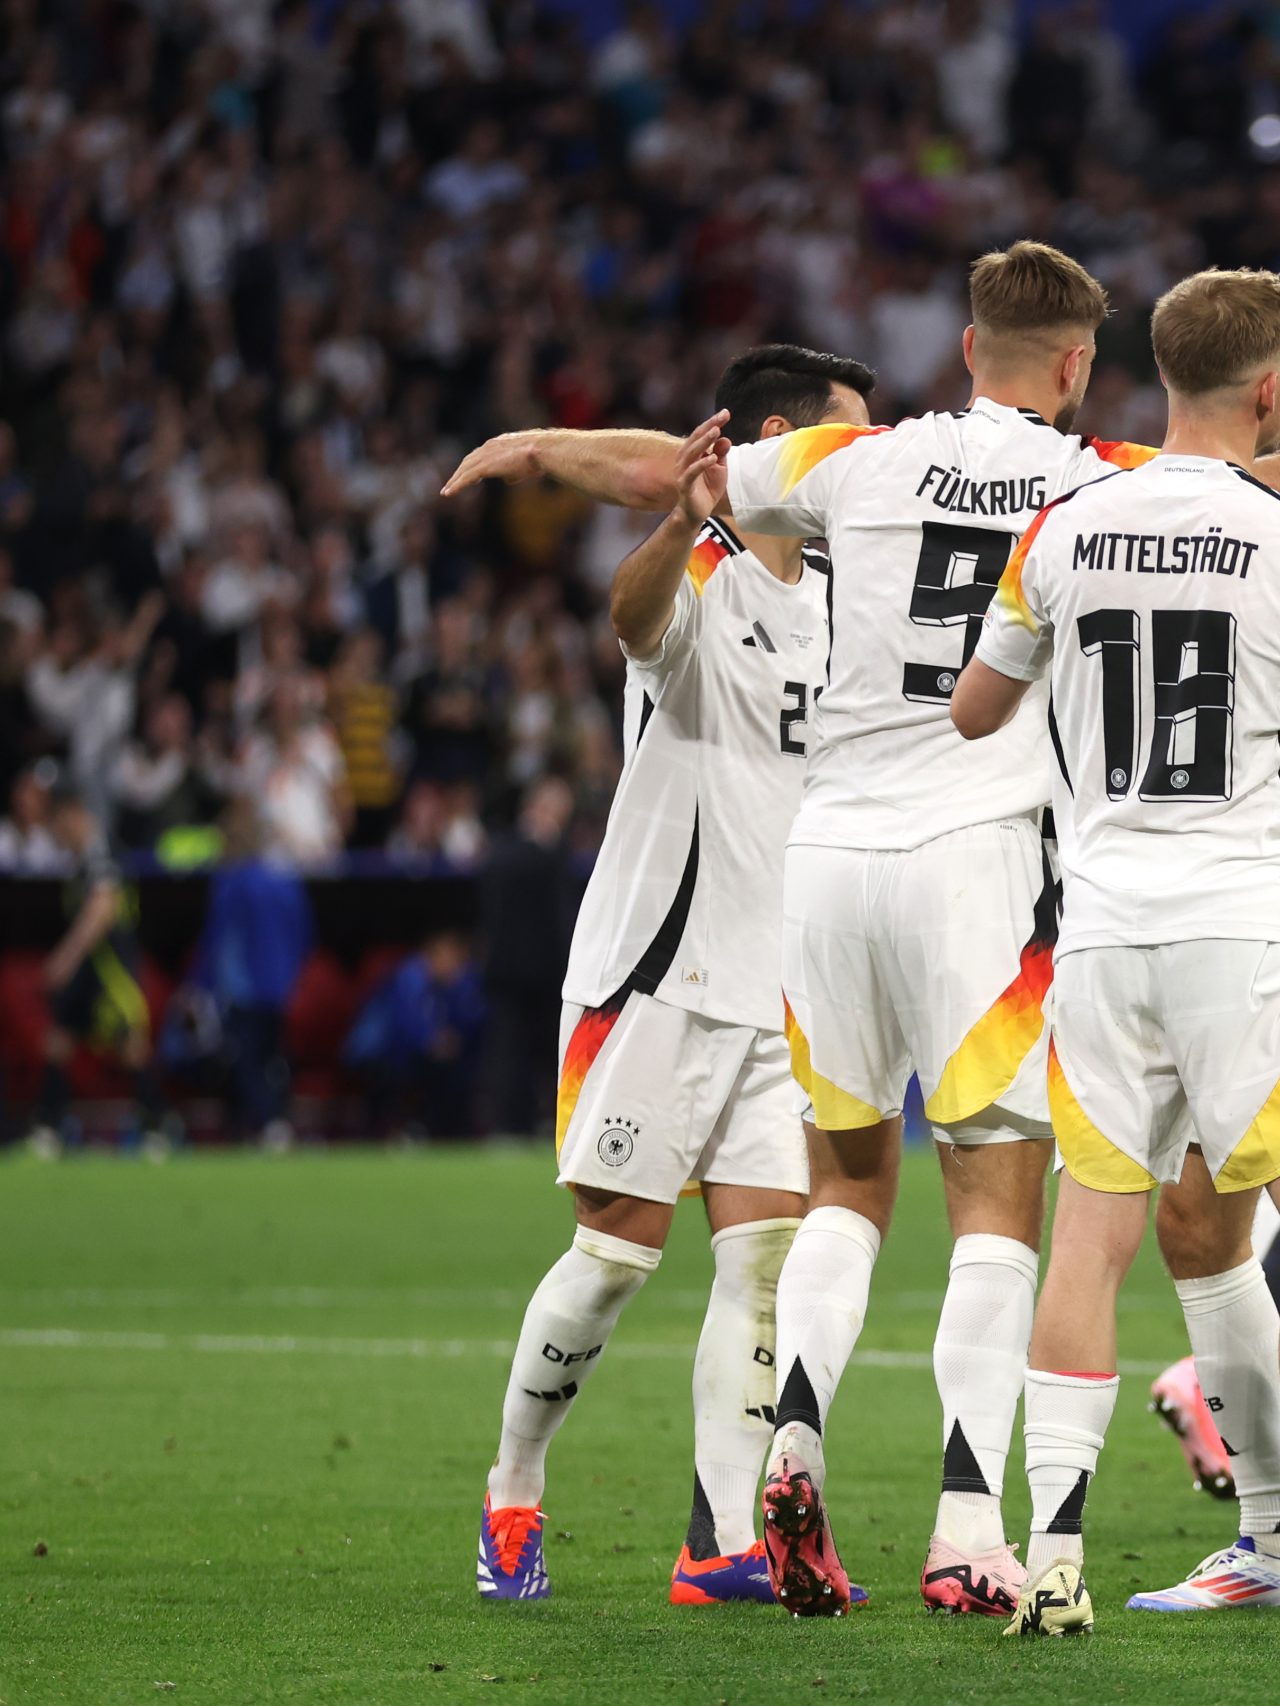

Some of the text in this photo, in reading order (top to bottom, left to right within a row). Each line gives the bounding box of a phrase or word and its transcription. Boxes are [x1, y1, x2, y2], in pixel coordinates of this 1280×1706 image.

[1072, 526, 1259, 579] MITTELSTÄDT
[902, 521, 1019, 705] 9
[779, 680, 824, 758] 2
[1076, 609, 1237, 802] 18
[542, 1342, 603, 1367] DFB
